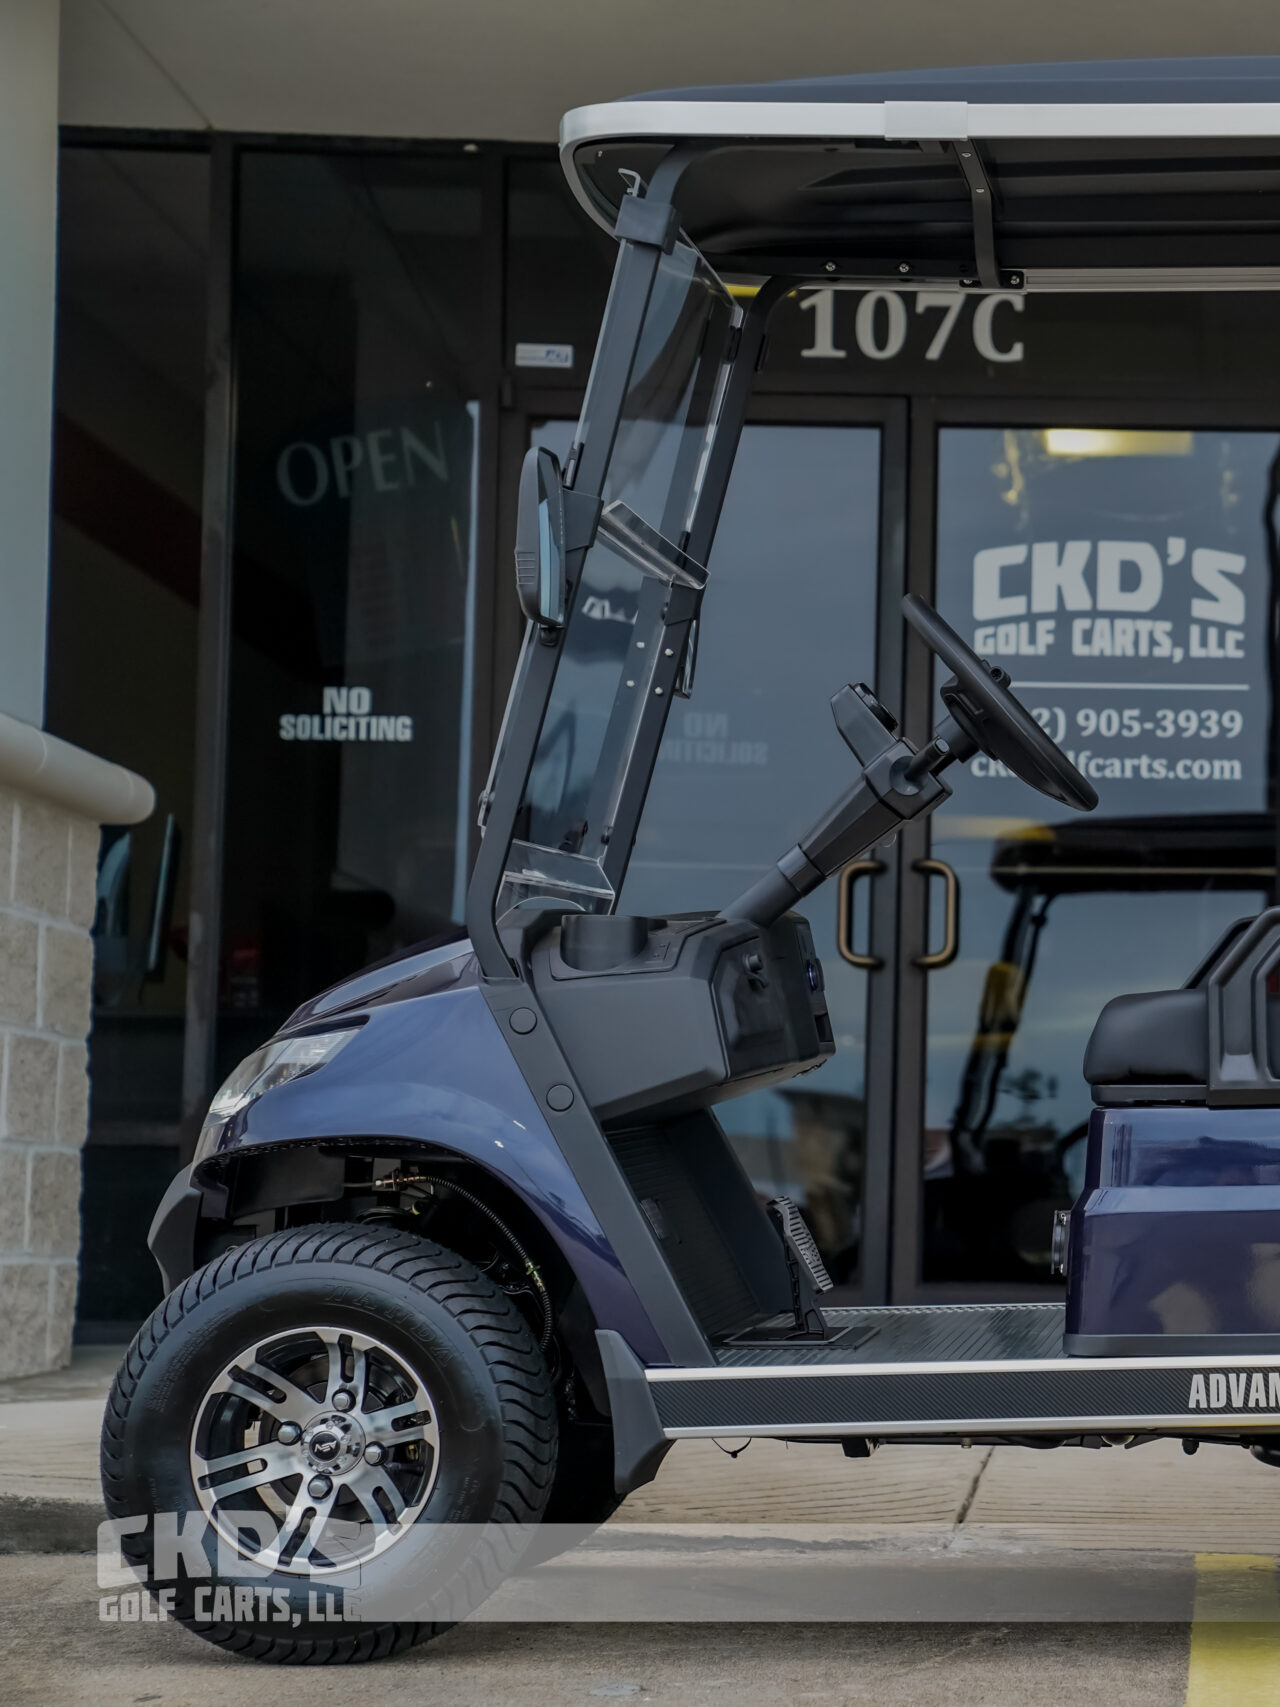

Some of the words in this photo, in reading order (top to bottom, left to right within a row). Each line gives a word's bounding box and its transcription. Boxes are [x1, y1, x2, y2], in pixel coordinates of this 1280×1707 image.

[798, 288, 1026, 363] 107C
[276, 420, 450, 507] OPEN
[972, 536, 1248, 627] CKD'S
[973, 619, 1057, 657] GOLF
[1071, 617, 1186, 664] CARTS,
[1188, 623, 1246, 659] LLC
[322, 685, 372, 715] NO
[1075, 707, 1243, 739] 905-3939
[279, 714, 413, 741] SOLICITING
